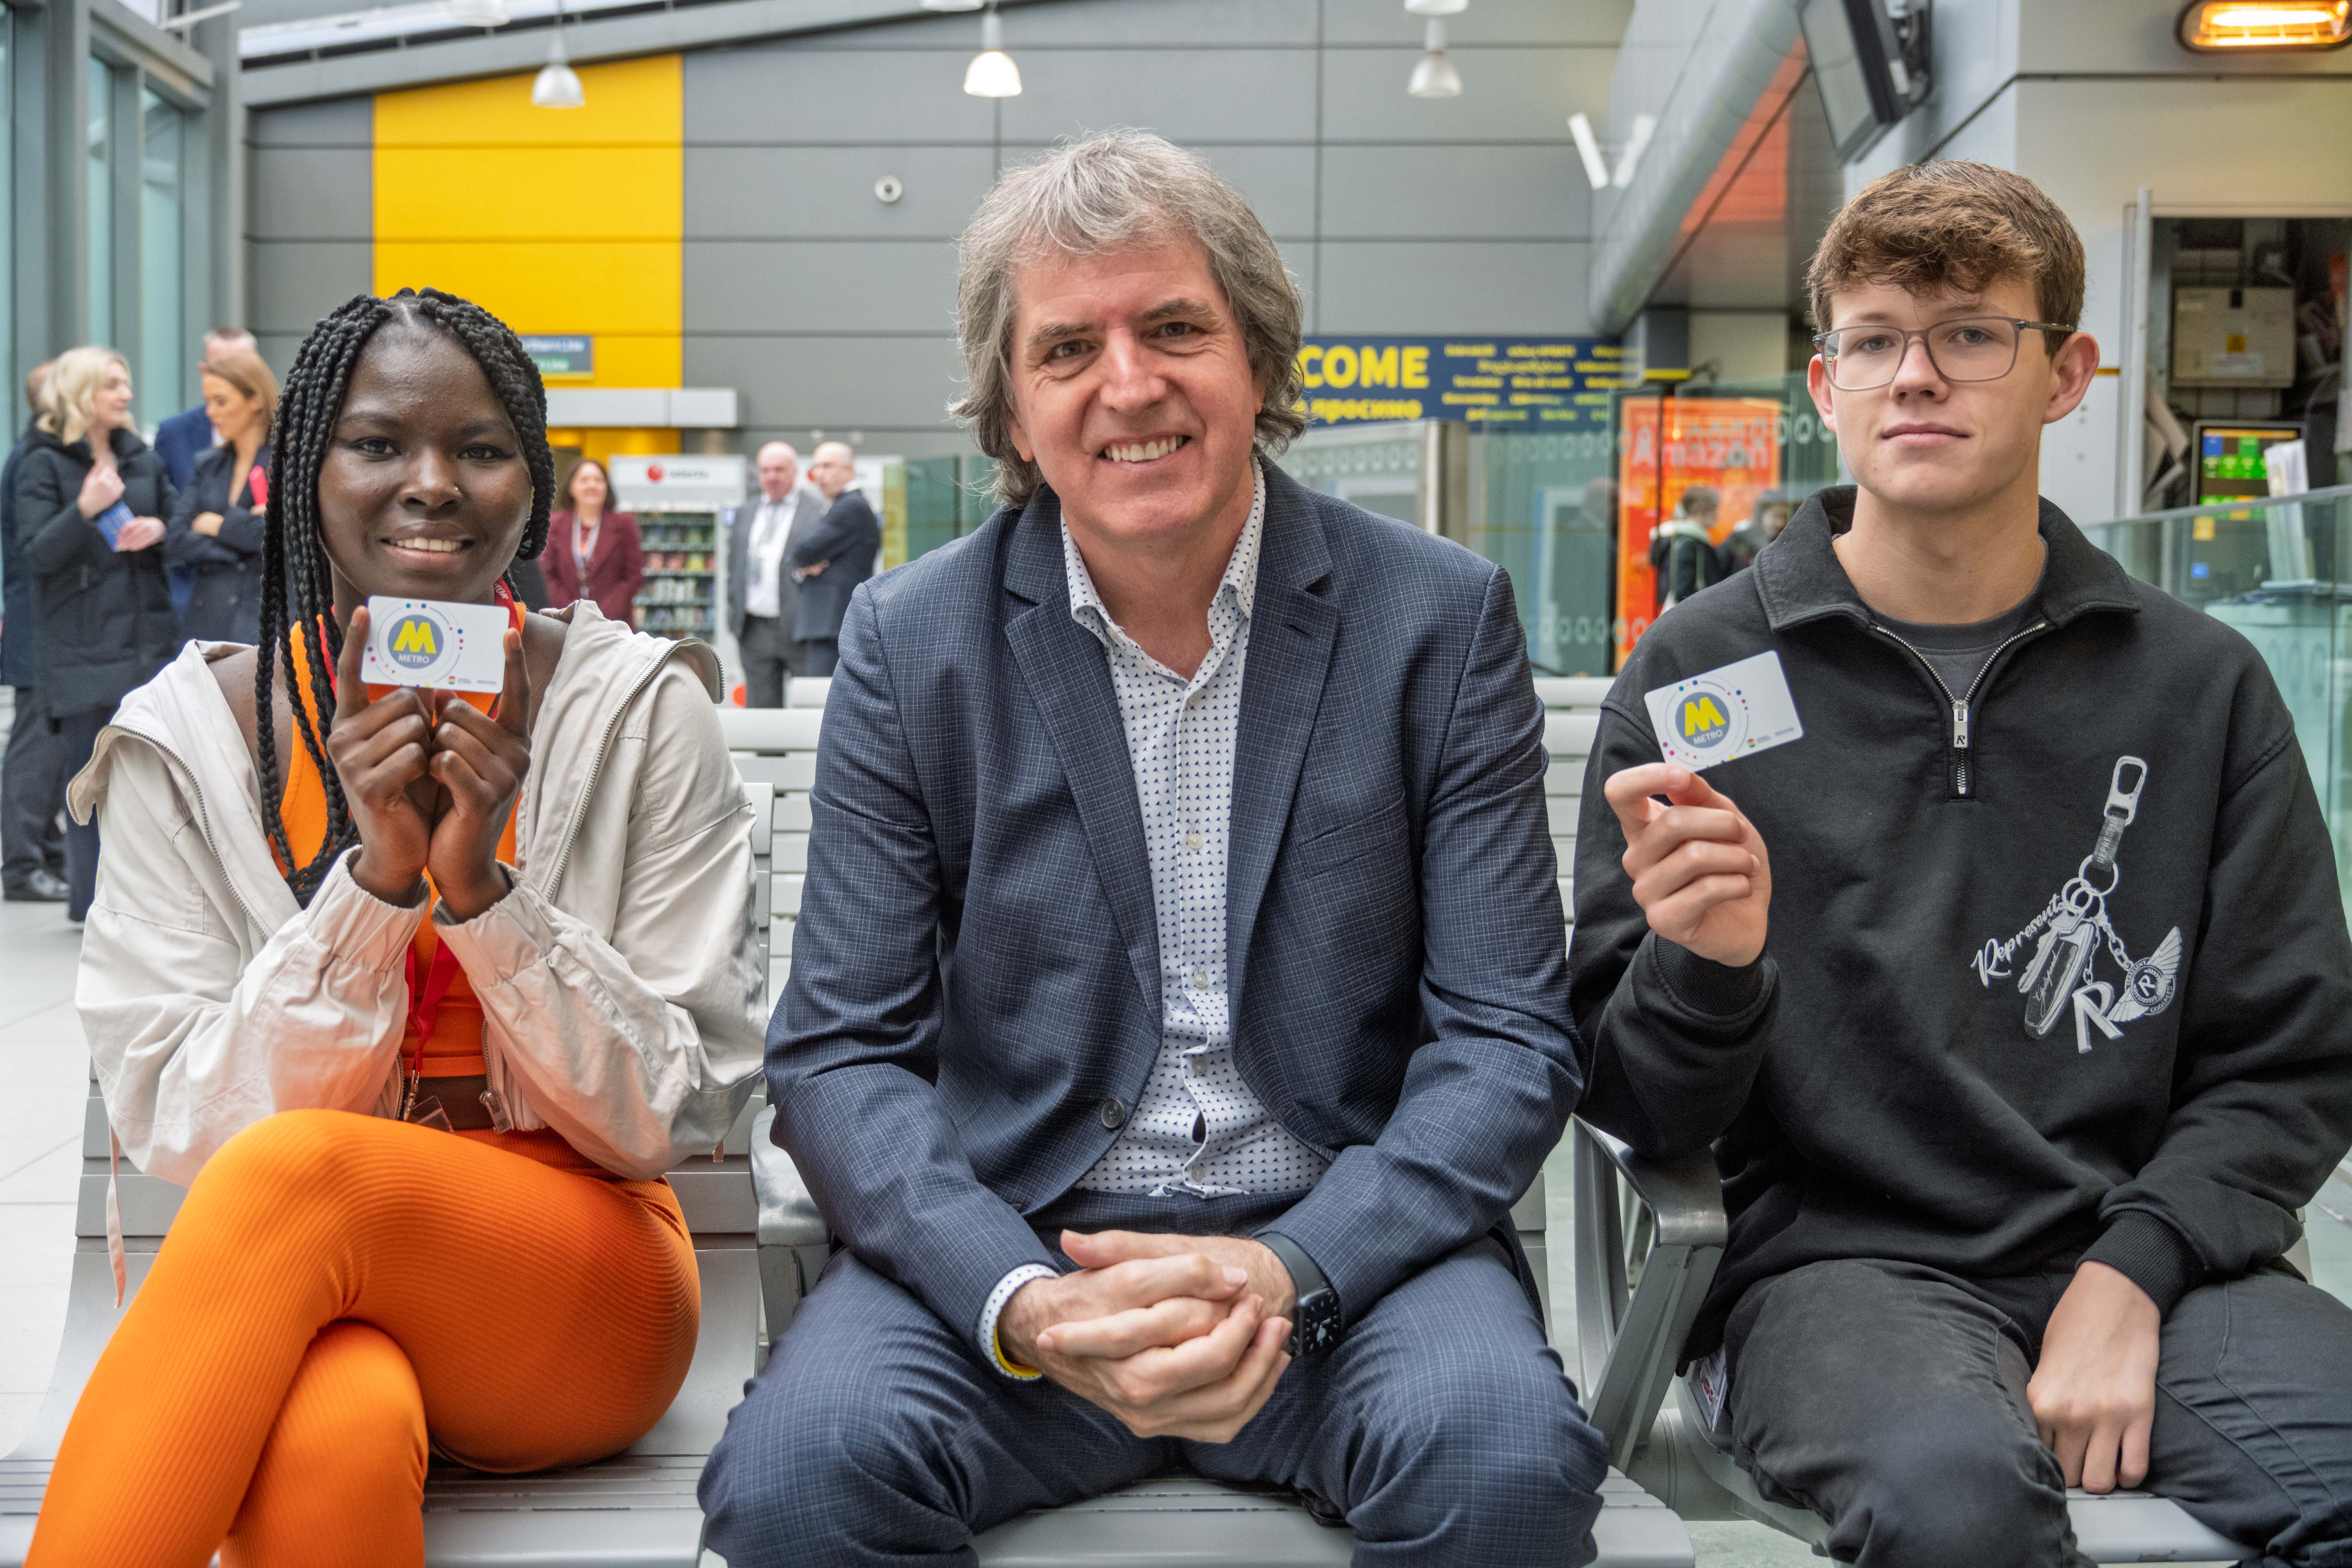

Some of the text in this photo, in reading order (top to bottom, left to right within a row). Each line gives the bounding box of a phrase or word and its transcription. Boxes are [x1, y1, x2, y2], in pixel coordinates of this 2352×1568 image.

[1296, 346, 1429, 388] COME
[393, 620, 437, 654] M
[398, 654, 430, 664] METRO
[1685, 697, 1726, 737] M
[1693, 729, 1723, 745] METRO
[1970, 893, 2060, 987] Represent
[2126, 960, 2147, 986] REPRESENT
[2150, 985, 2173, 1013] GODSPEED
